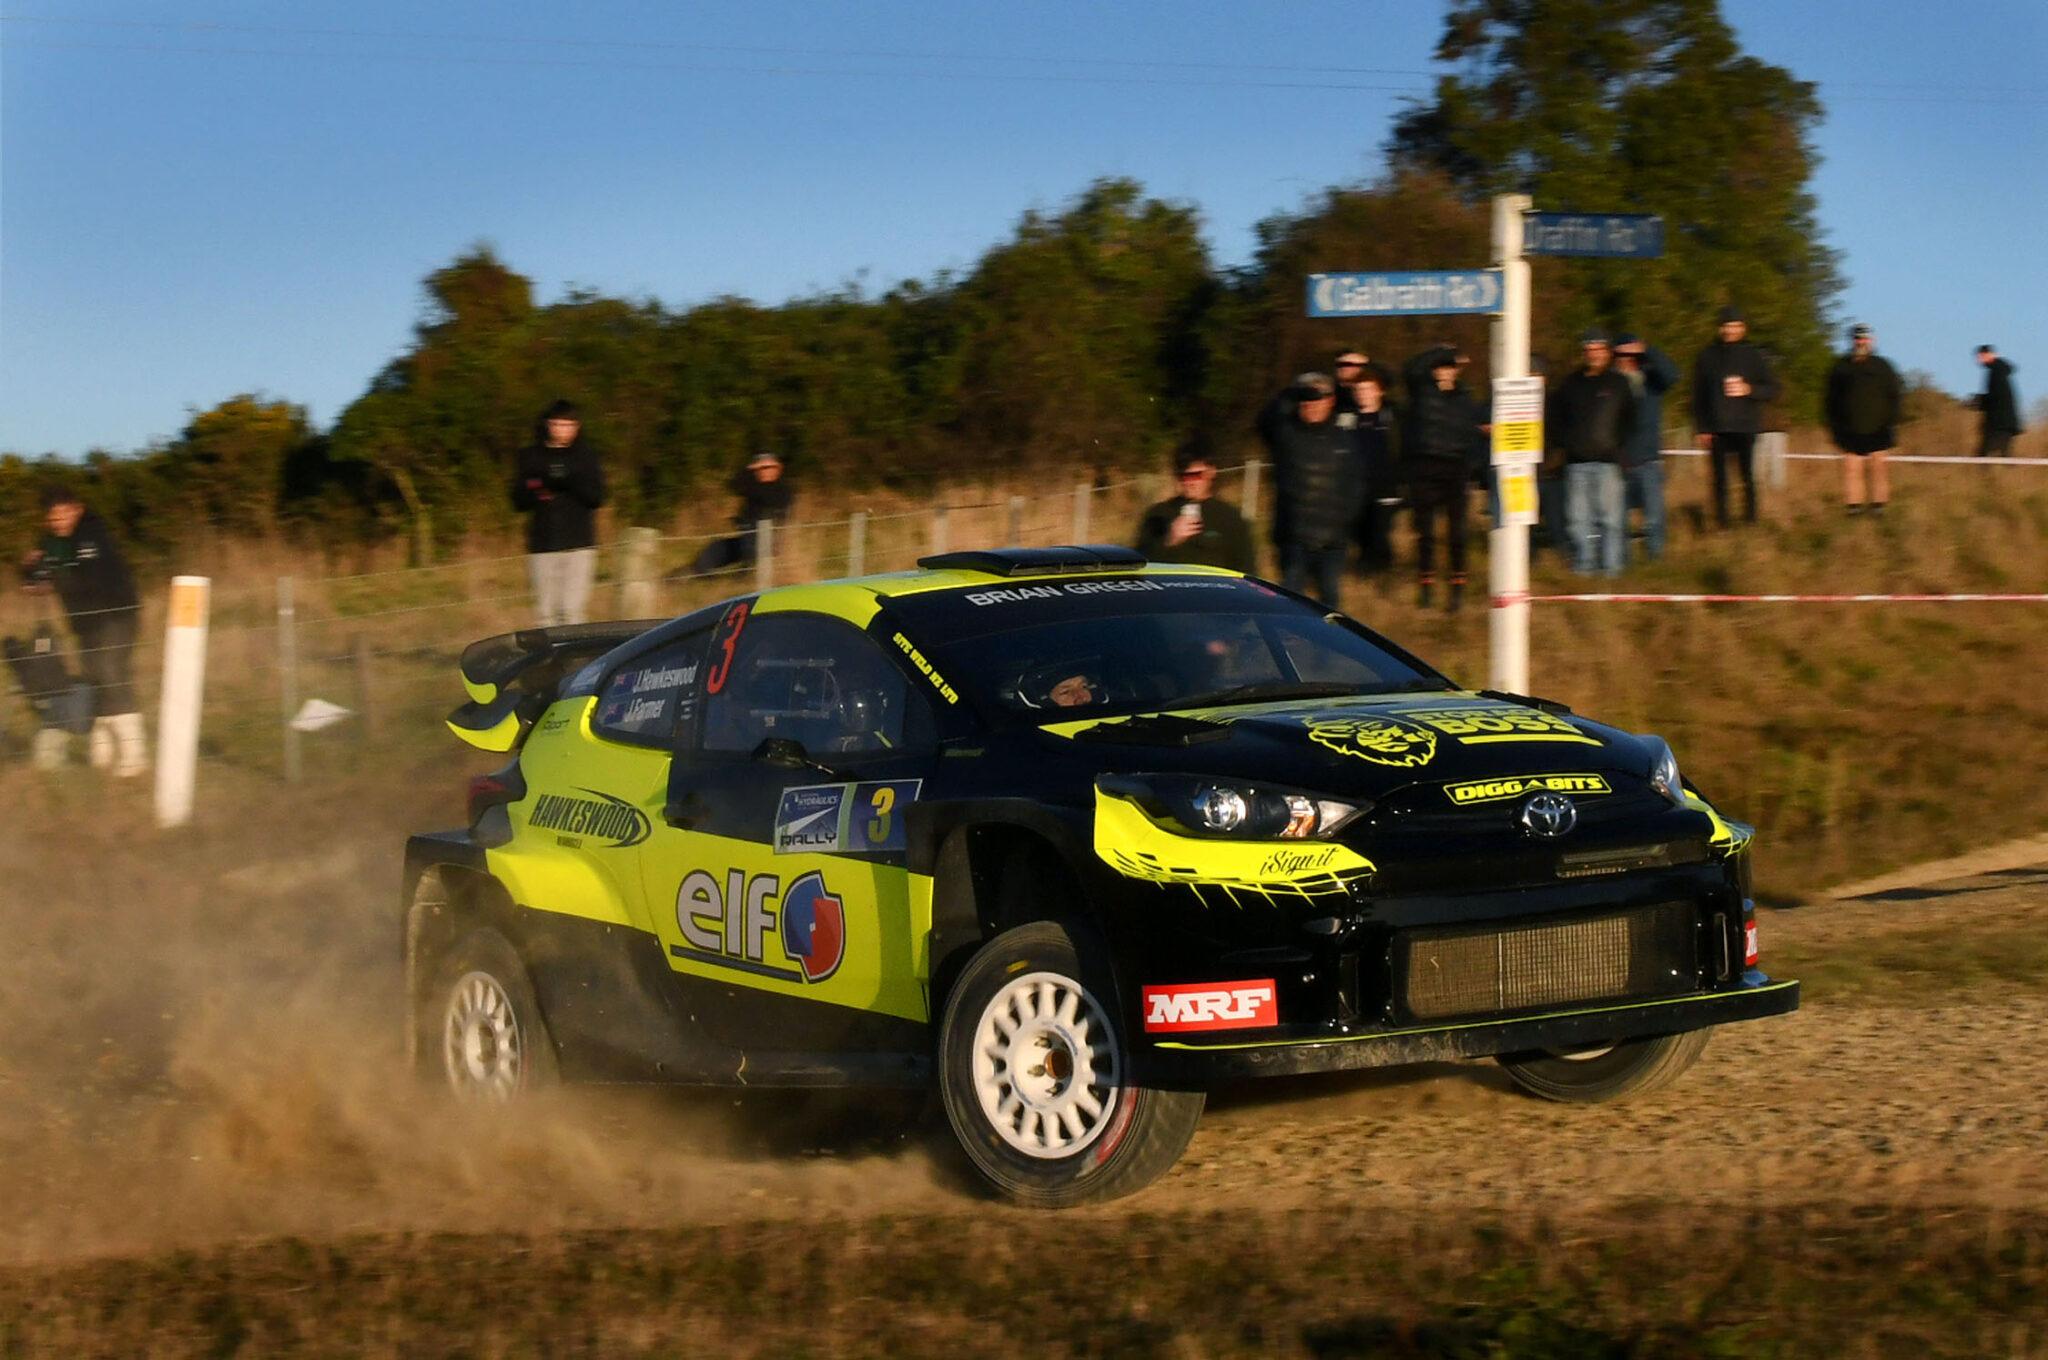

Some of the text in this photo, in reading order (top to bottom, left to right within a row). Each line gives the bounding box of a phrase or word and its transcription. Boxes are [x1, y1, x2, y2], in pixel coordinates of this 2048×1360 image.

[965, 586, 1063, 606] BRIAN
[1064, 580, 1163, 595] GREEN
[707, 603, 749, 695] 3
[940, 683, 959, 704] LTD
[1427, 714, 1583, 735] BOSS
[528, 794, 640, 845] HAWKESWOOD
[868, 787, 895, 843] 3
[780, 832, 837, 847] RALLY
[676, 867, 780, 963] elf
[1147, 988, 1271, 1023] MRF
